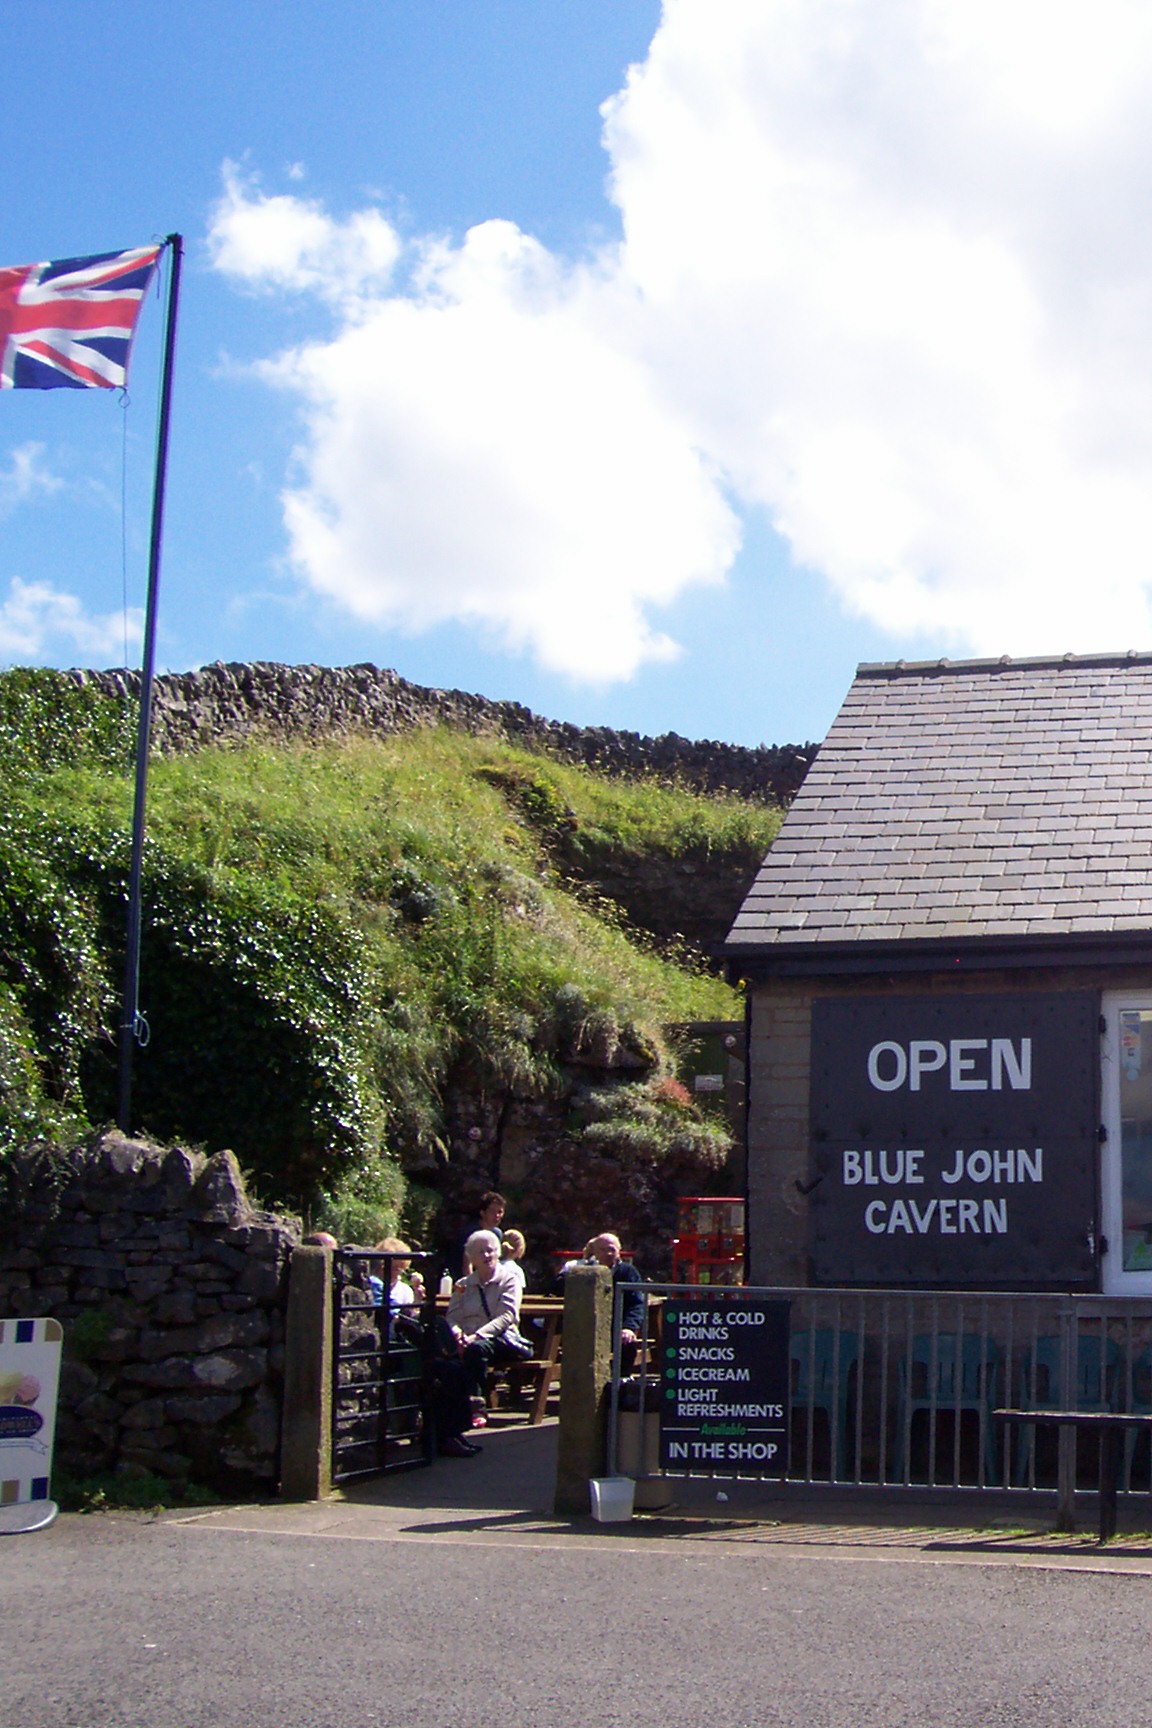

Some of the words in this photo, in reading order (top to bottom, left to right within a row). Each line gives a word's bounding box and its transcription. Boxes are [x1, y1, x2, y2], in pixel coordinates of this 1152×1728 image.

[867, 1038, 1032, 1091] OPEN
[843, 1150, 925, 1185] BLUE
[941, 1148, 1043, 1183] JOHN
[864, 1198, 1008, 1234] CAVERN
[678, 1312, 709, 1325] HOT
[711, 1312, 723, 1325] &
[726, 1312, 765, 1325] COLD
[678, 1327, 729, 1340] DRINKS
[678, 1347, 735, 1361] SNACKS
[678, 1367, 750, 1381] ICECREAM
[678, 1388, 718, 1401] LIGHT
[677, 1403, 783, 1418] REFRESHMENTS
[700, 1422, 746, 1436] Available
[669, 1442, 688, 1458] IN
[692, 1442, 725, 1459] THE
[728, 1443, 778, 1459] SHOP
